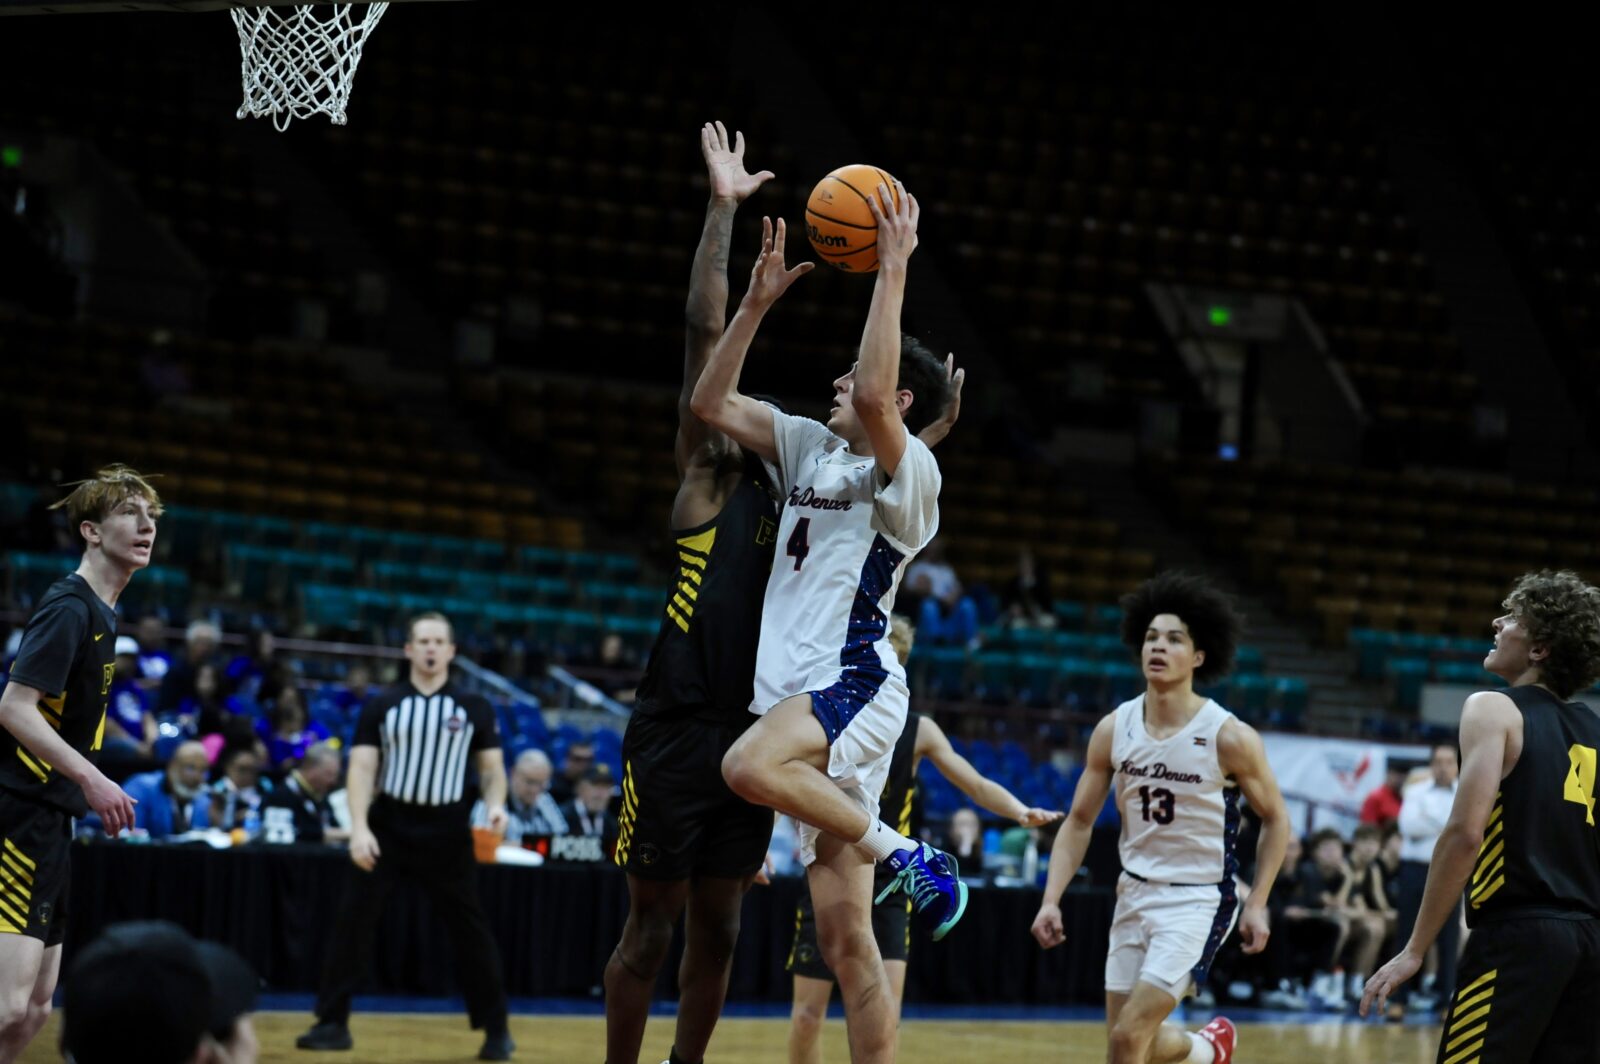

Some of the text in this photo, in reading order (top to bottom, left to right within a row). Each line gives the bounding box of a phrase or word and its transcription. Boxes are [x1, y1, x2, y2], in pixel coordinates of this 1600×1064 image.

[799, 486, 852, 511] Denver
[786, 516, 811, 571] 4
[1118, 758, 1203, 784] Kent Denver
[1563, 743, 1597, 827] 4
[1138, 784, 1175, 825] 13
